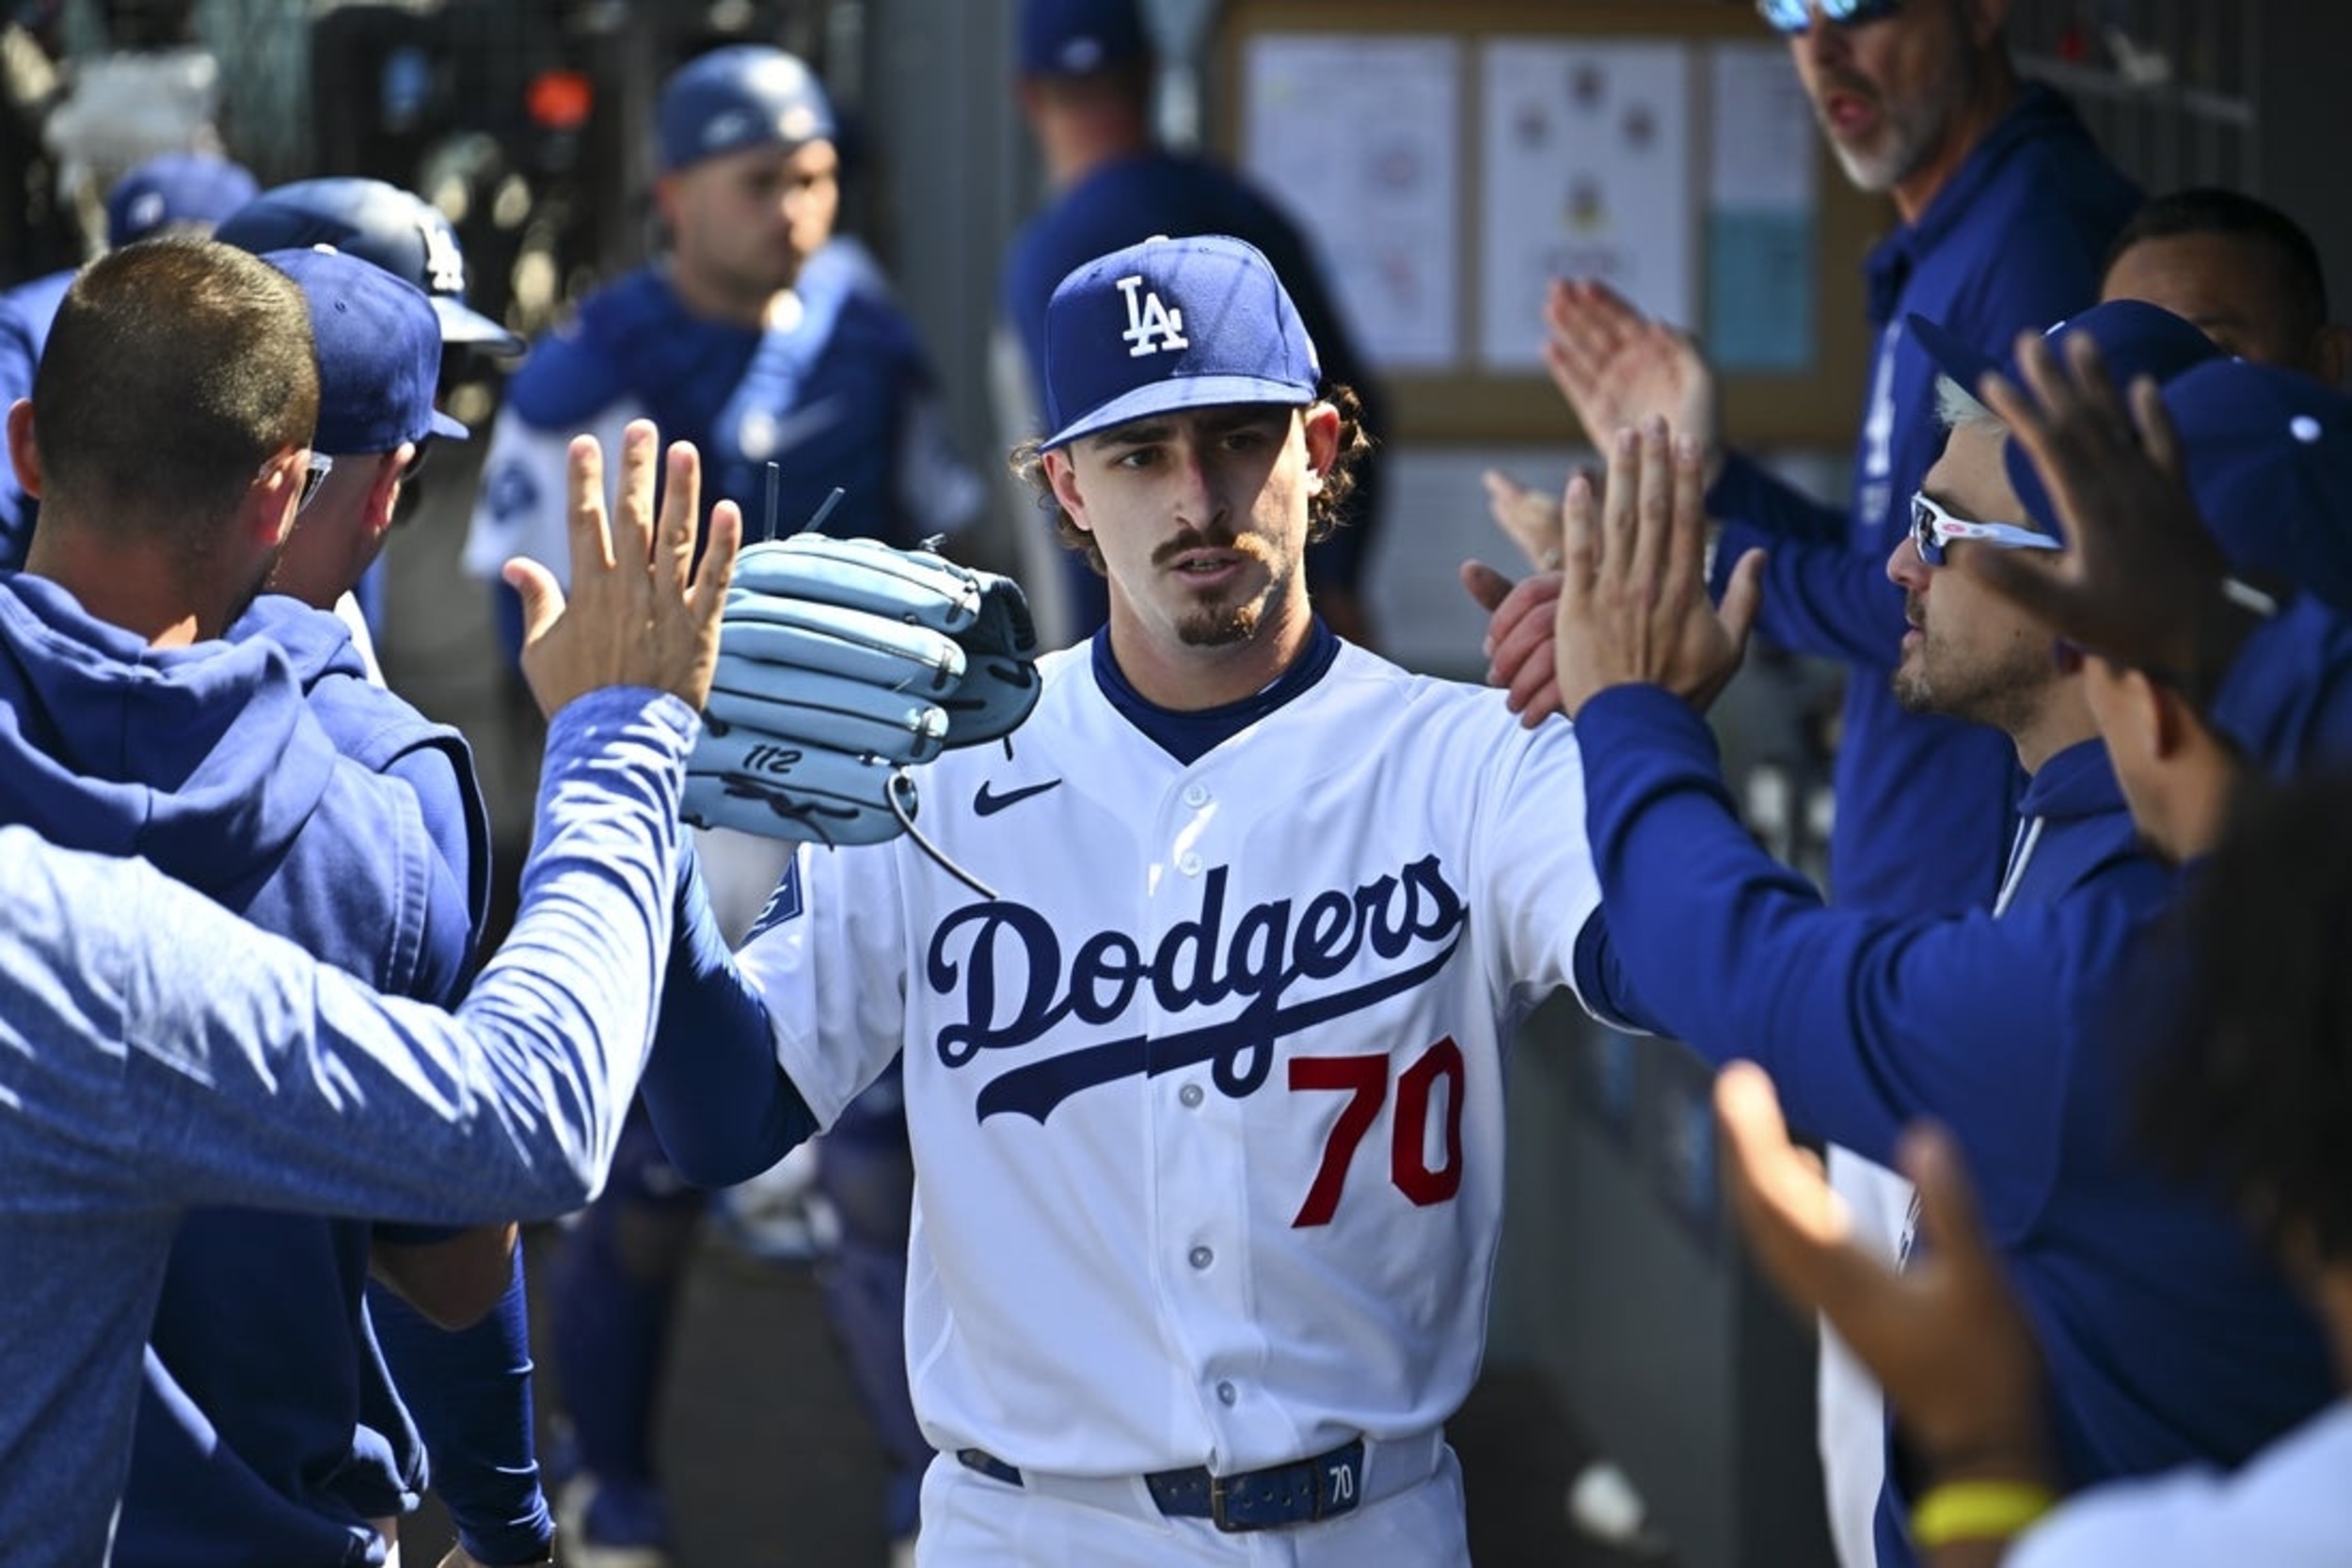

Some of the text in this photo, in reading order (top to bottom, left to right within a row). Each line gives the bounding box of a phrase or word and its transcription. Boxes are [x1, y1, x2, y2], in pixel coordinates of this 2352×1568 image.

[1116, 275, 1189, 357] LA
[742, 744, 803, 775] 112
[928, 854, 1470, 1099] Dodgers
[1289, 1036, 1465, 1228] 70
[1328, 1464, 1354, 1504] 70
